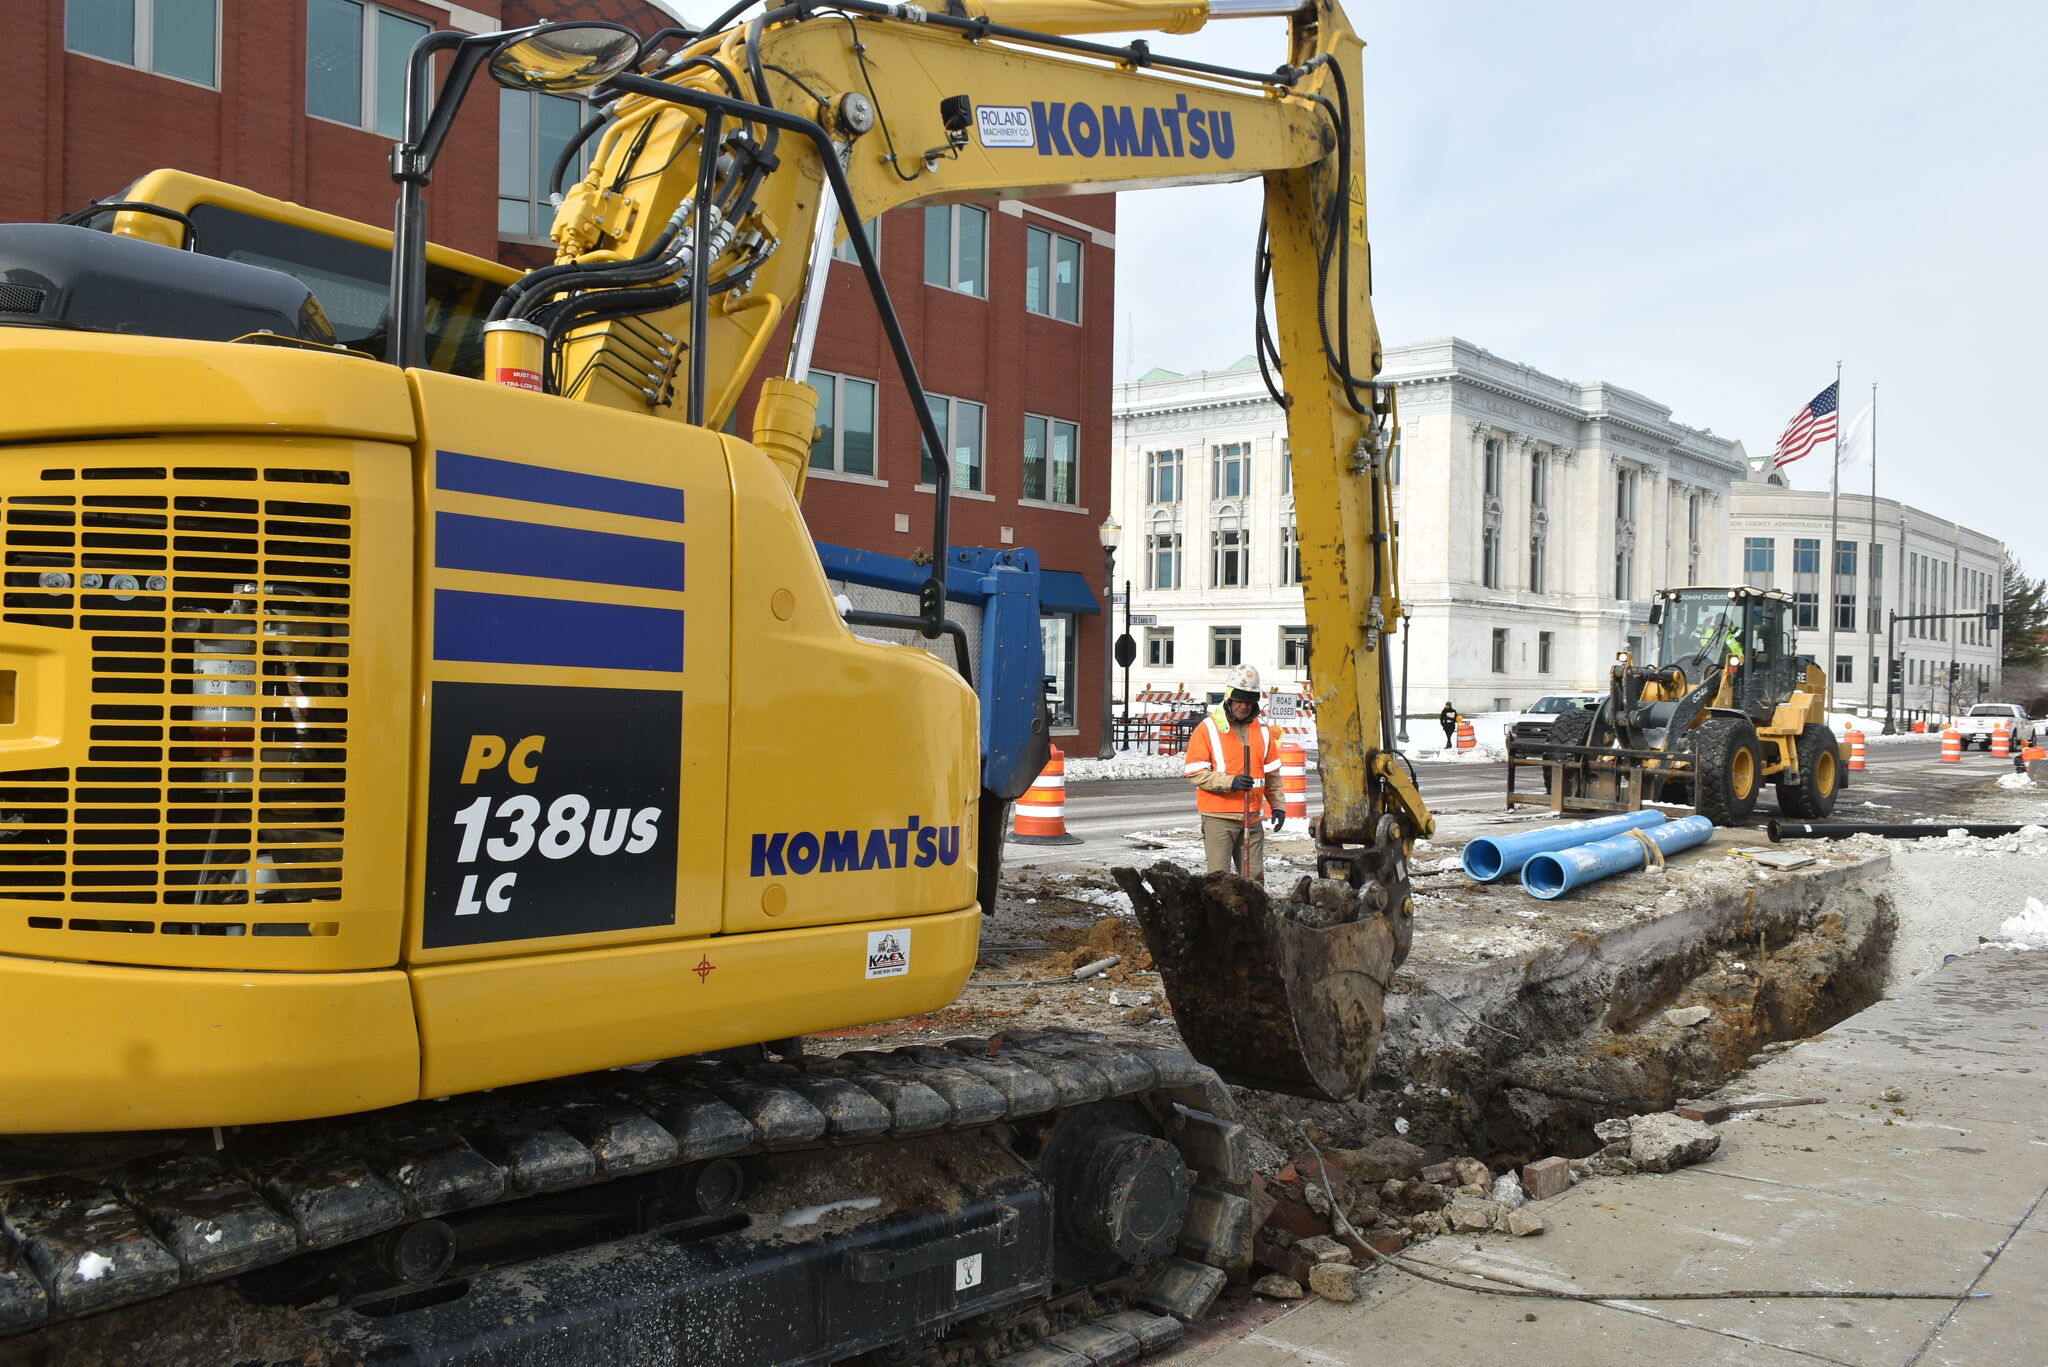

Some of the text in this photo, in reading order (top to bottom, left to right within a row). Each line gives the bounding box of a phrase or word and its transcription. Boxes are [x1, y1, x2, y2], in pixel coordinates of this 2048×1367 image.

[981, 110, 1027, 126] ROLAND
[983, 128, 1018, 136] MACHINERY
[1031, 94, 1235, 160] KOMATSU
[1774, 520, 1823, 529] ADMINISTRATION
[1276, 697, 1292, 705] ROAD
[1272, 707, 1294, 715] CLOSED
[459, 734, 546, 785] PC
[750, 815, 960, 878] KOMATSU
[454, 871, 518, 916] LC
[869, 952, 905, 967] KAMEX
